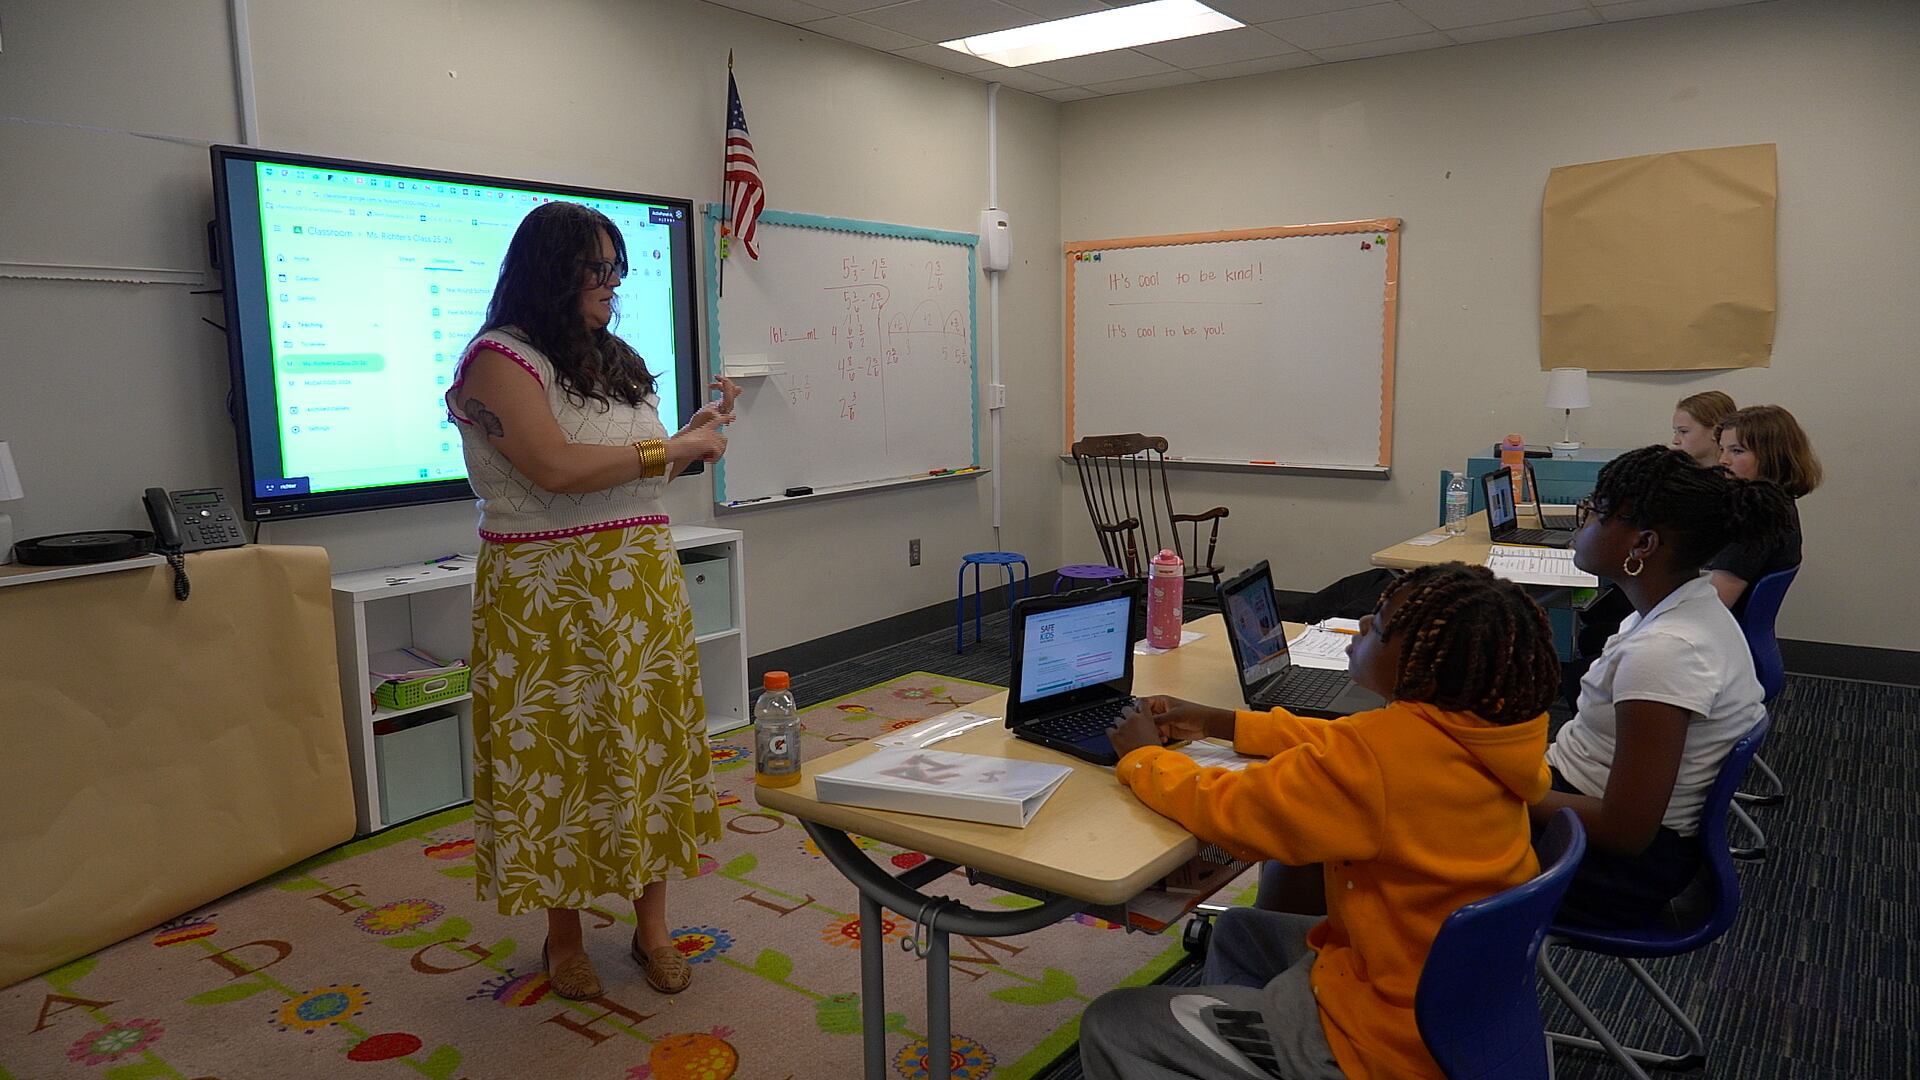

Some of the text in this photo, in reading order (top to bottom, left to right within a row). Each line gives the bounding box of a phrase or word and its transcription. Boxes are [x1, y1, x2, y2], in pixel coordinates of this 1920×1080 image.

[307, 226, 353, 239] Classroom
[413, 233, 431, 243] Class
[1109, 272, 1130, 291] It's
[1138, 272, 1159, 288] cool
[1176, 272, 1190, 285] to
[1199, 270, 1217, 282] be
[1108, 322, 1225, 341] It's cool to be you!
[1040, 624, 1056, 633] SAFE
[1040, 632, 1055, 641] KIDS
[769, 735, 788, 755] G
[198, 939, 293, 982] D
[28, 993, 124, 1035] A
